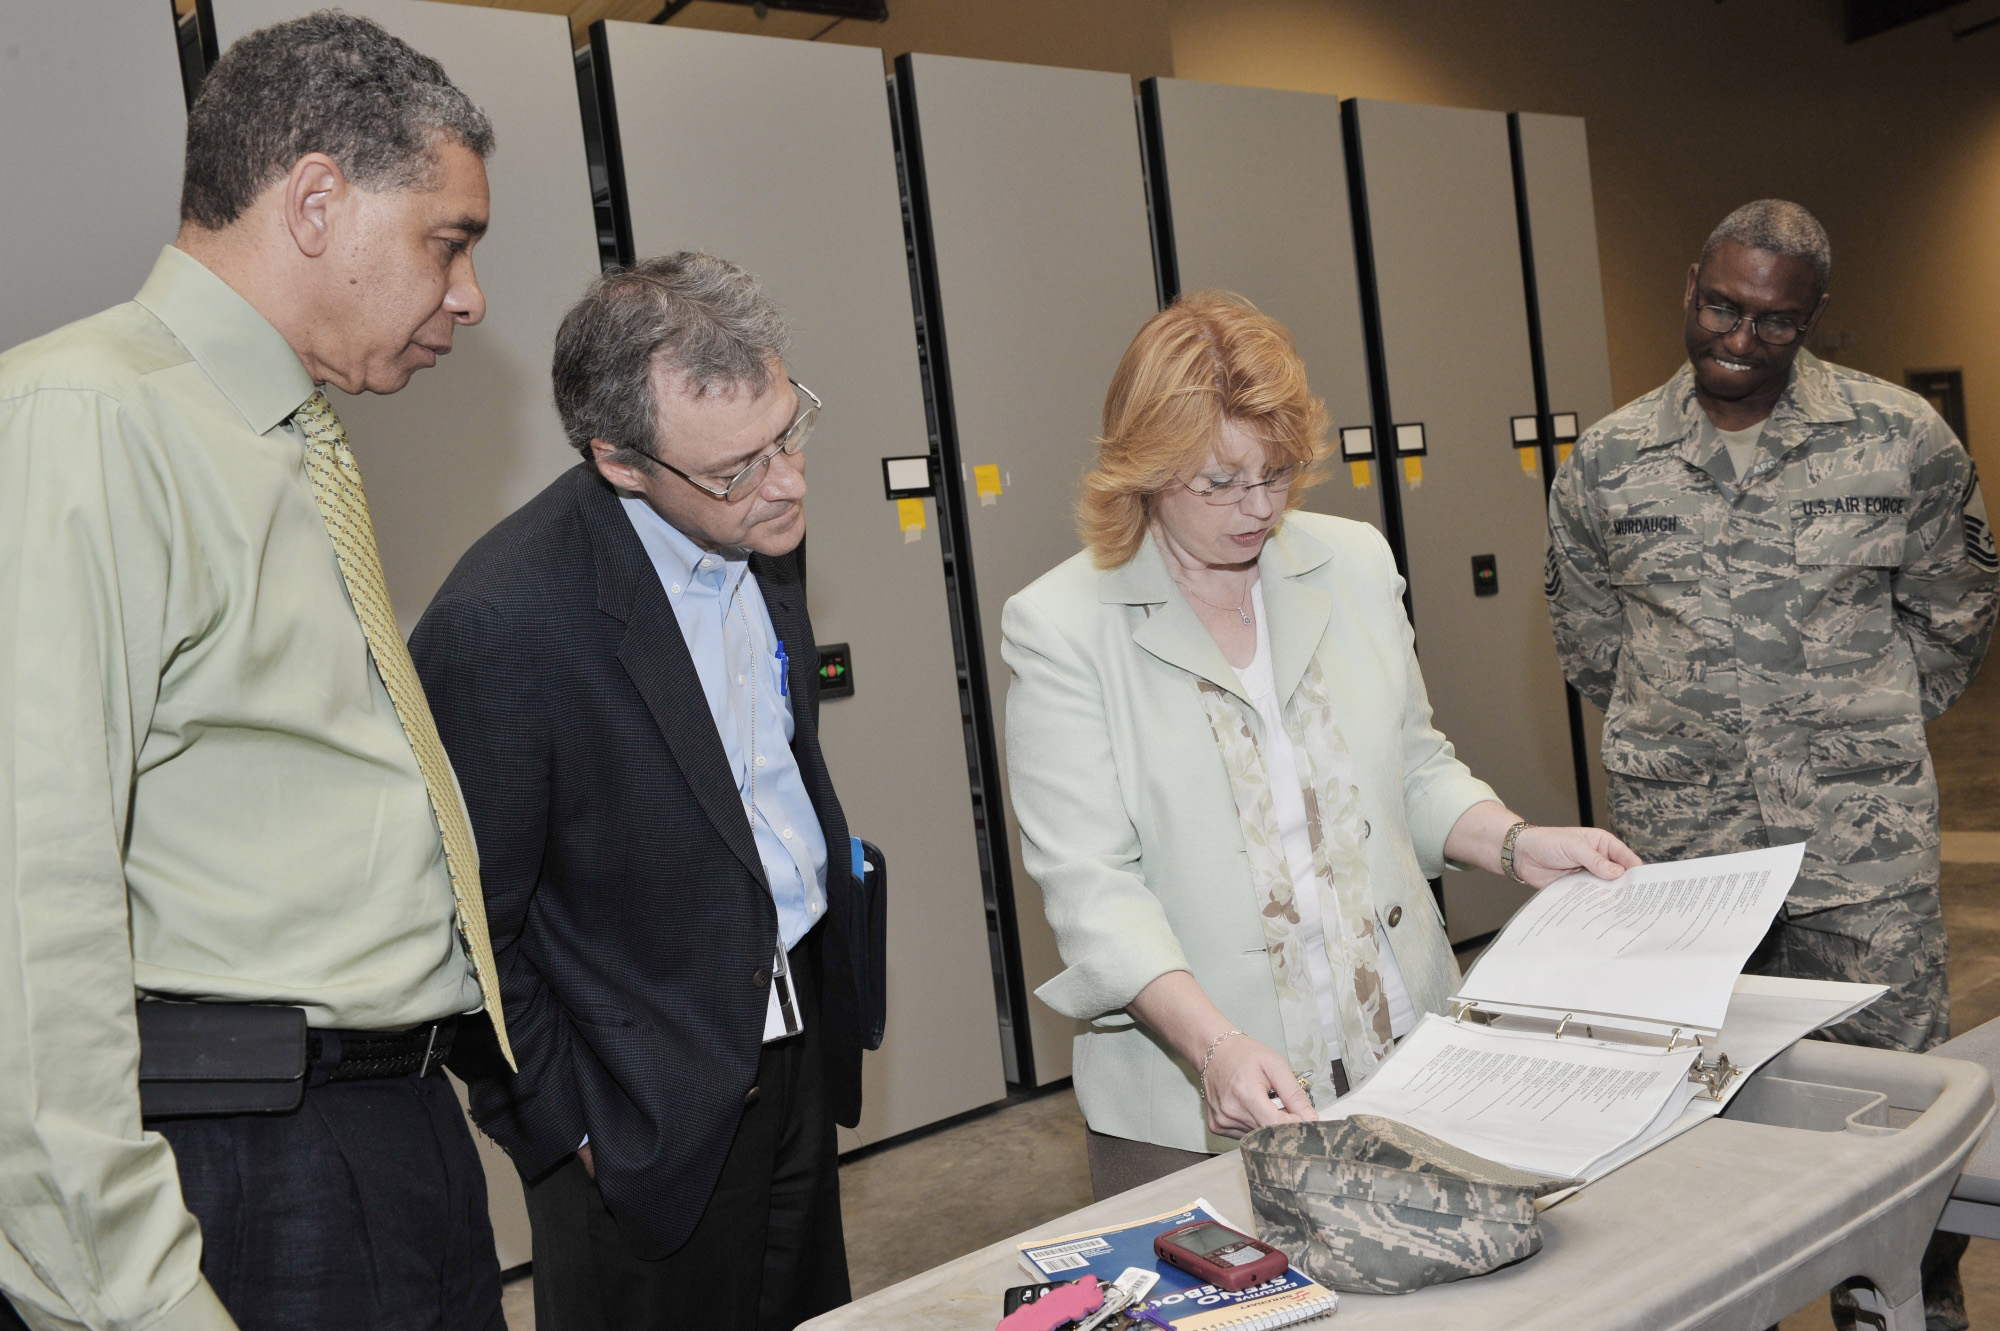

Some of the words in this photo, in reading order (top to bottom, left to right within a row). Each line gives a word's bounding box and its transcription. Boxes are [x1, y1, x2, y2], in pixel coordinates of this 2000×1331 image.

[1753, 460, 1780, 474] AFC
[1802, 500, 1832, 515] U.S.
[1835, 496, 1860, 514] AIR
[1864, 496, 1904, 514] FORCE
[1614, 516, 1677, 535] MURDAUGH
[1235, 1282, 1298, 1302] EXECUTIVE
